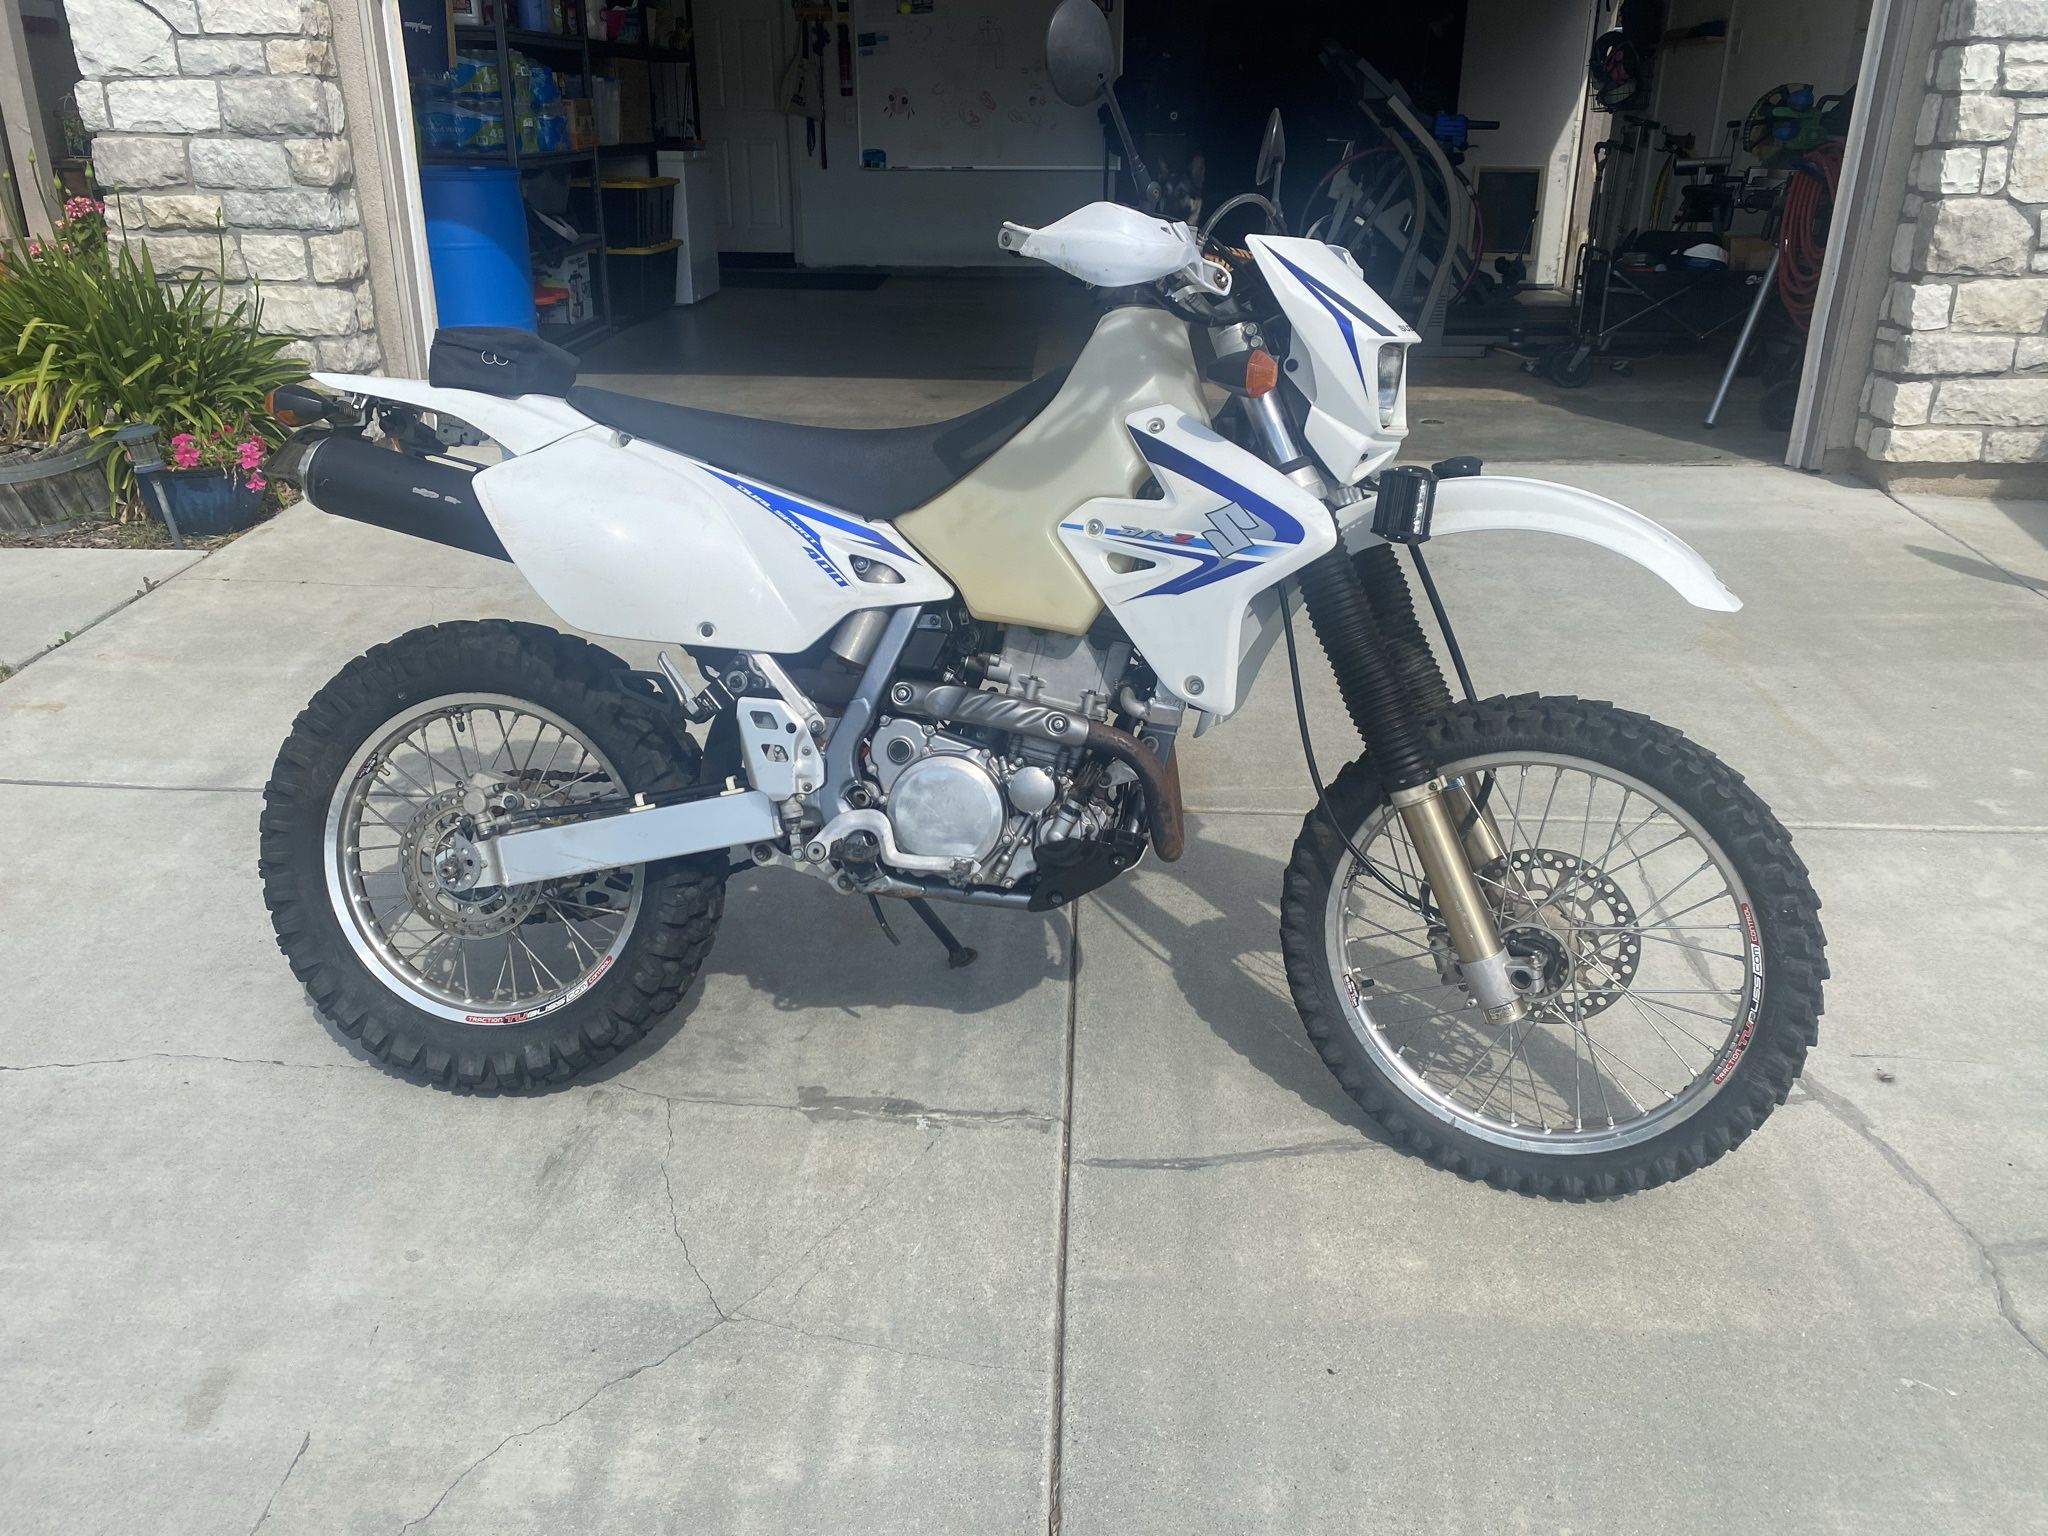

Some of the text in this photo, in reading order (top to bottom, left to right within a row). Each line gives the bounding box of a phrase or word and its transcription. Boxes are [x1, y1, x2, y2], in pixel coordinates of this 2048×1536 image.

[736, 484, 820, 546] DUAL SPORT
[802, 546, 850, 587] 400
[467, 1015, 503, 1023] TRACTION
[588, 958, 612, 984] CONTROL
[1715, 1048, 1742, 1082] TRACTION
[1744, 907, 1758, 942] CONTROL
